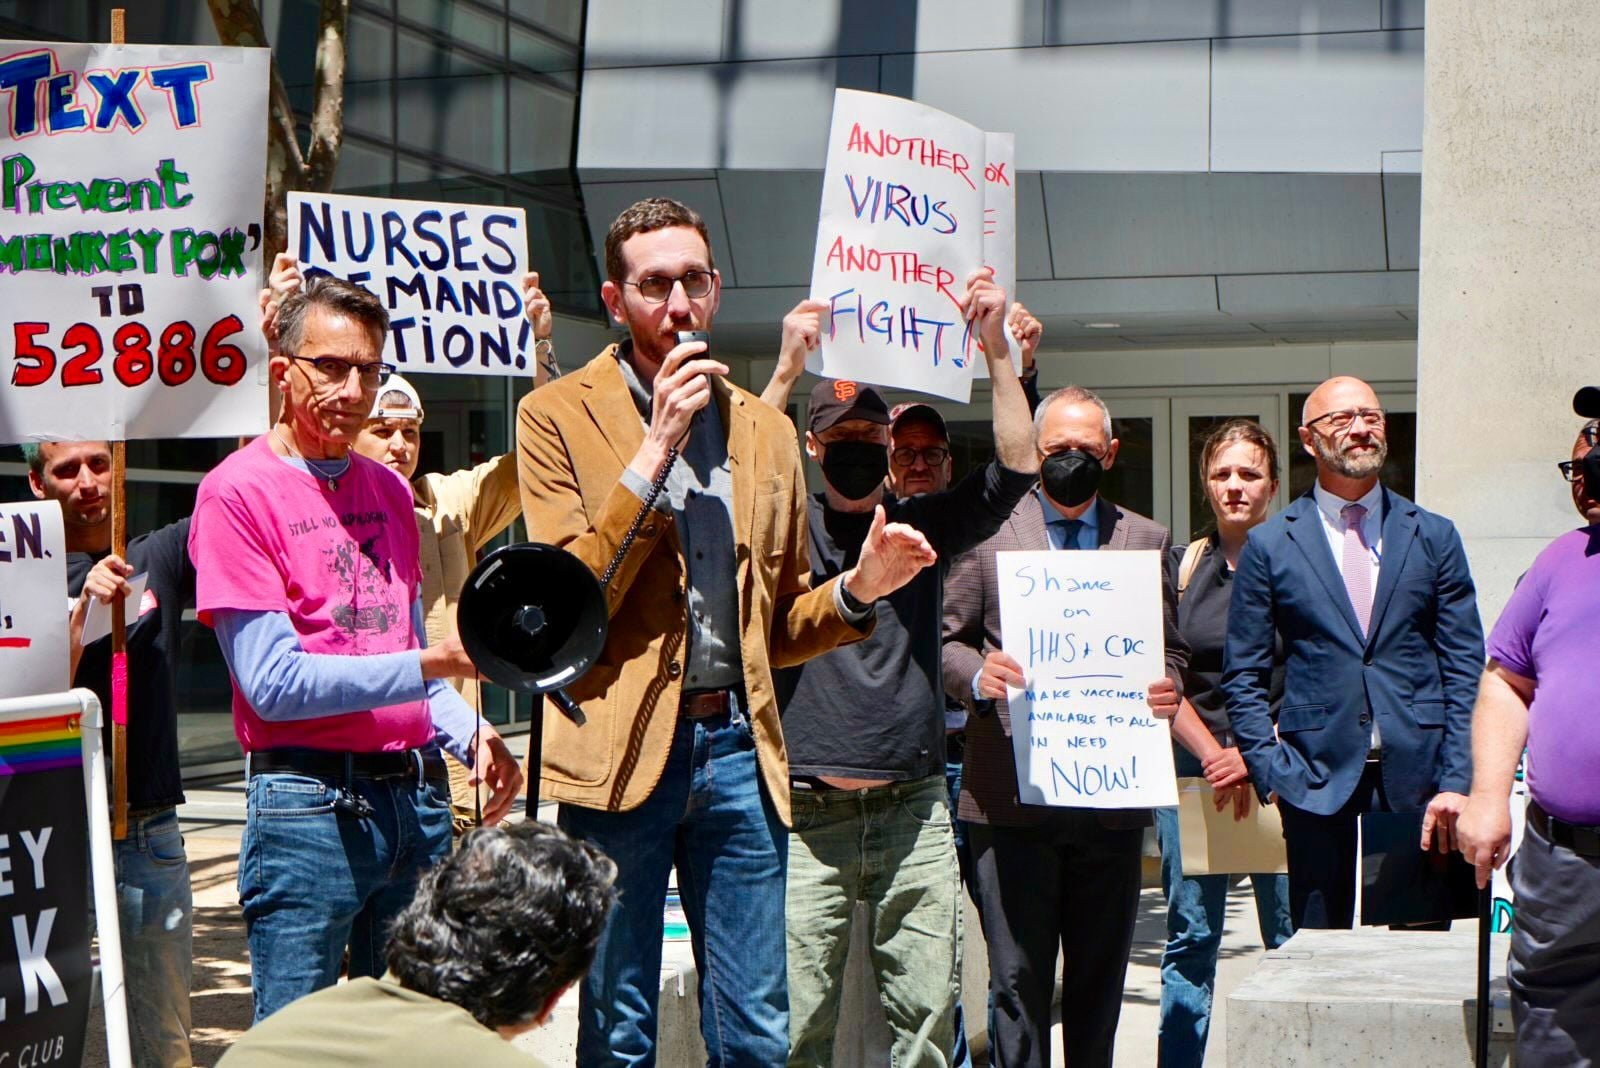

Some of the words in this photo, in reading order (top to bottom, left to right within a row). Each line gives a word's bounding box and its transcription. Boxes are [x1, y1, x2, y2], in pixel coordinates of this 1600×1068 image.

[0, 48, 213, 141] TEXT
[847, 123, 976, 190] ANOTHER
[2, 153, 194, 214] Prevent
[845, 174, 957, 234] VIRUS
[299, 202, 517, 274] NURSES
[302, 266, 523, 320] MAND
[826, 236, 964, 313] ANOTHER
[91, 283, 145, 317] TO
[828, 288, 976, 368] FIGHT!
[11, 314, 248, 388] 52886
[288, 517, 319, 537] STILL
[321, 516, 338, 529] NO
[1015, 565, 1115, 598] Shame
[1063, 607, 1091, 618] on
[1104, 634, 1146, 658] CDC
[1025, 688, 1071, 702] MAKE
[1080, 687, 1145, 701] VACCINES
[1028, 711, 1097, 726] AVAILABLE
[1106, 713, 1125, 728] TO
[1129, 716, 1158, 729] ALL
[1030, 735, 1048, 749] IN
[1067, 735, 1108, 750] NEED
[1050, 755, 1140, 799] NOW!
[18, 1035, 65, 1068] CLUB
